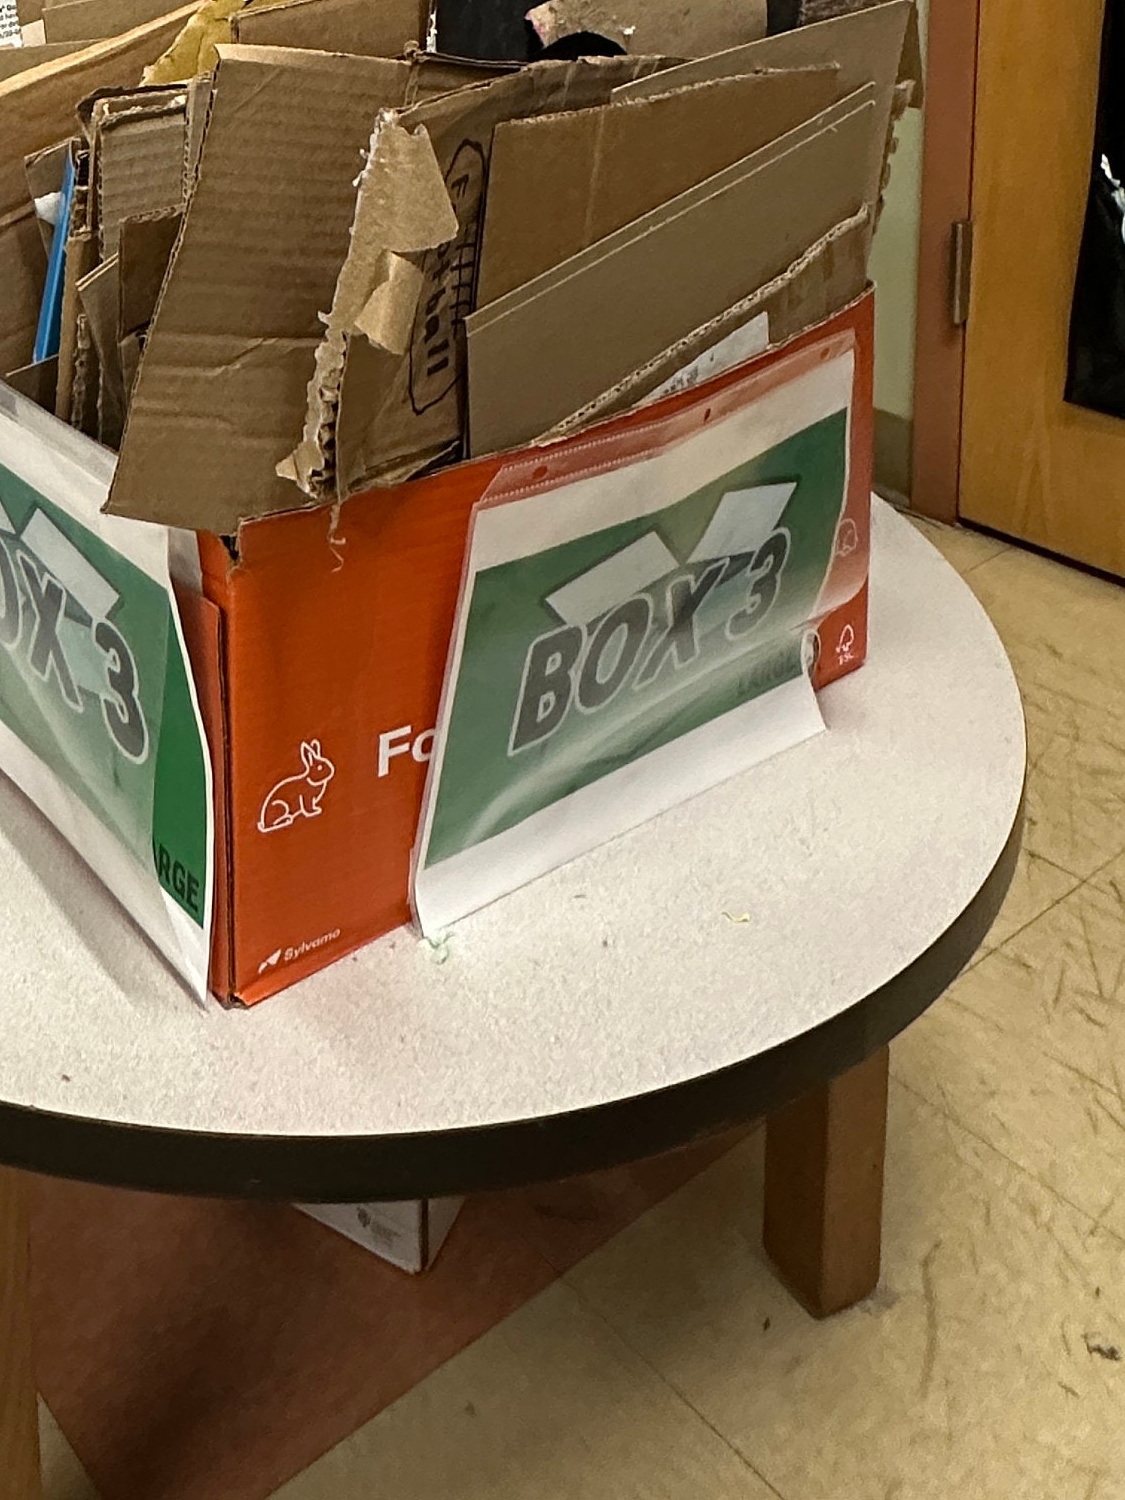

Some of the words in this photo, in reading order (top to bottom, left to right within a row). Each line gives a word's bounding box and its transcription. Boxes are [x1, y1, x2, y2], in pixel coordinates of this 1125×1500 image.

[92, 617, 148, 763] 3
[508, 556, 730, 756] BOX
[725, 527, 791, 639] 3
[283, 927, 341, 961] Sylvamo
